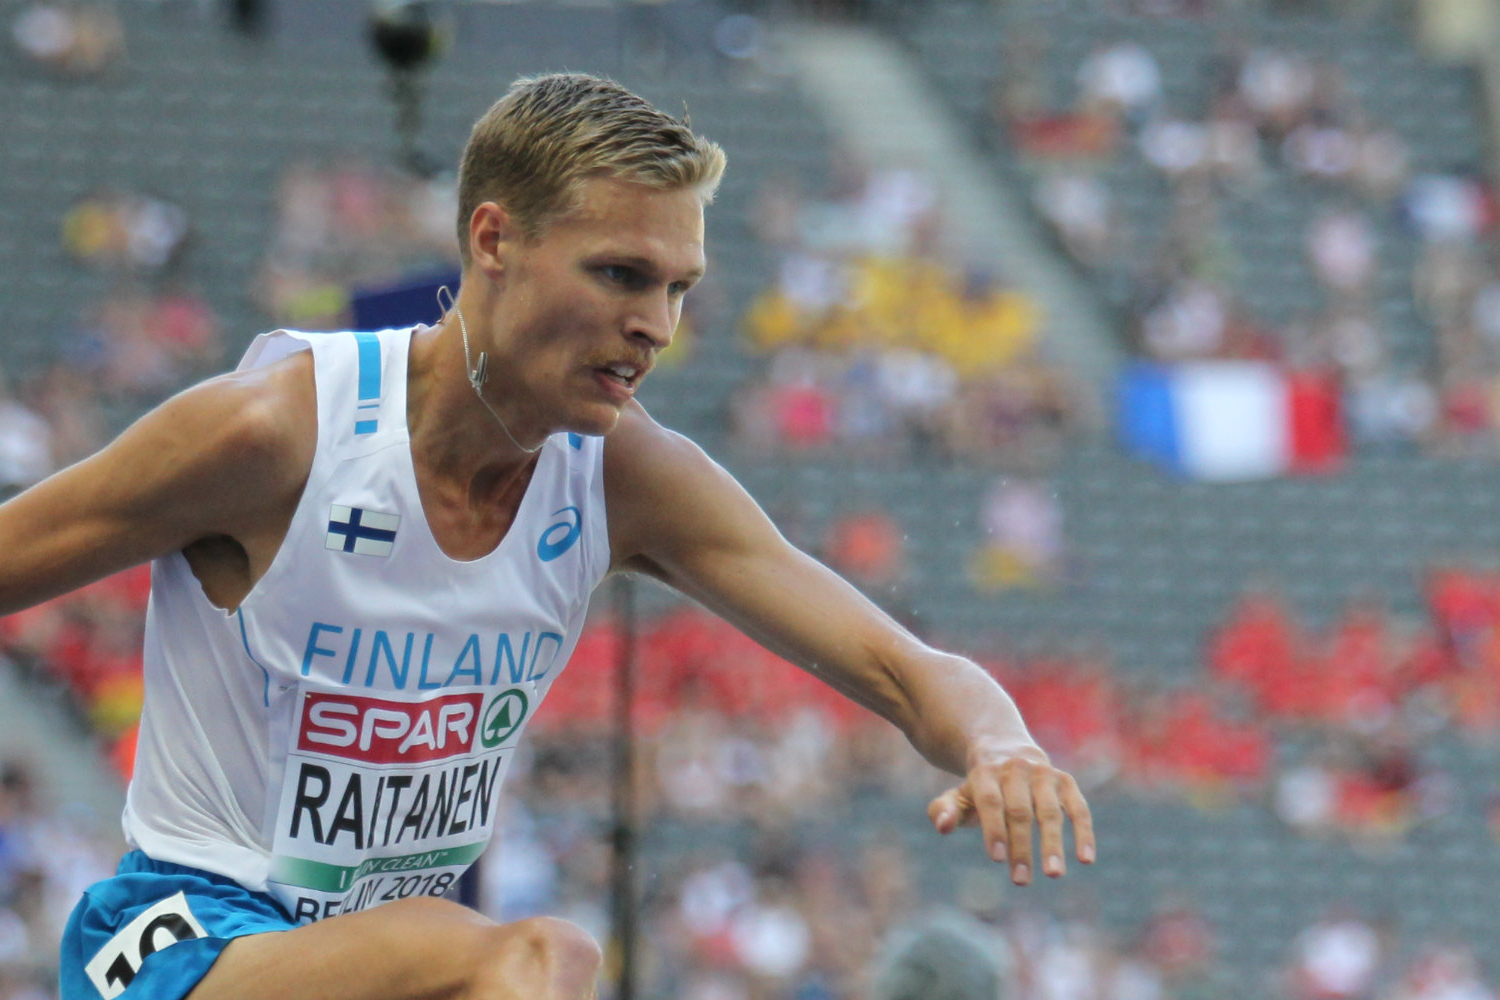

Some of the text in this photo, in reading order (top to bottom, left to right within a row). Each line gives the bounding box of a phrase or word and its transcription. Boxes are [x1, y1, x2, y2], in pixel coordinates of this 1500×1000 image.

[301, 622, 563, 690] FINLAND
[306, 701, 474, 754] SPAR
[289, 756, 502, 849] RAITANEN
[295, 872, 455, 924] BELIN 2018
